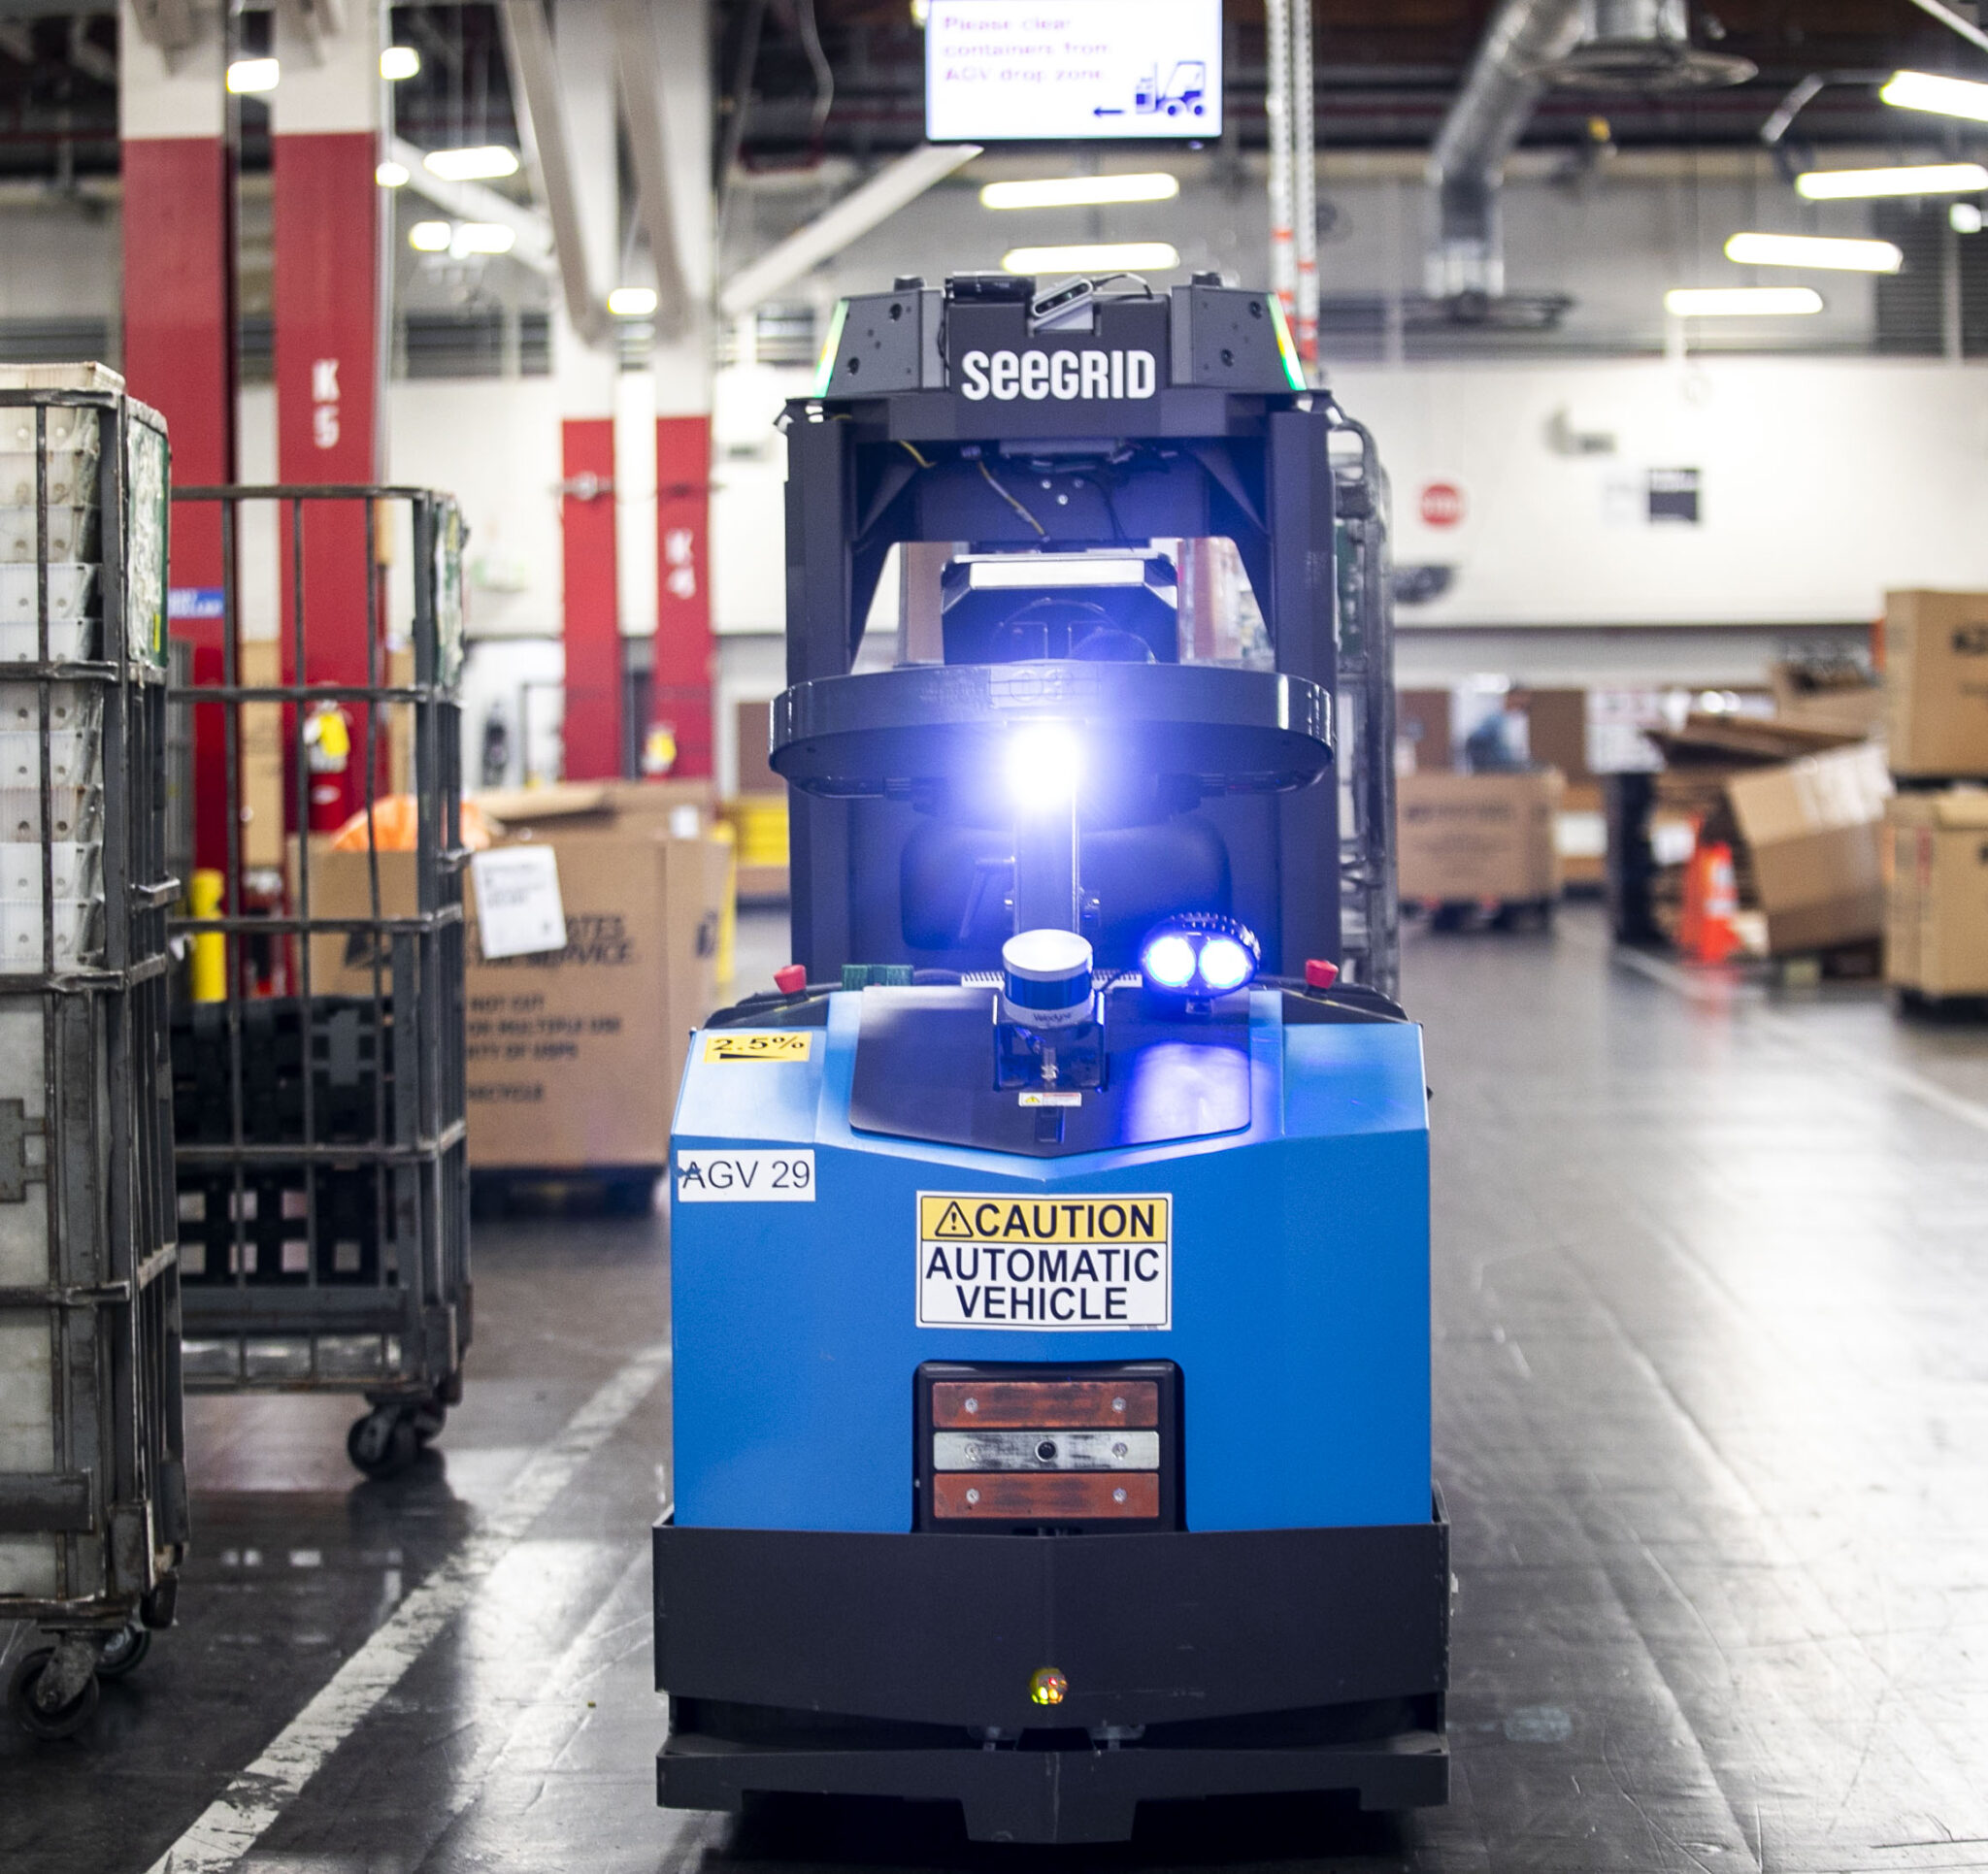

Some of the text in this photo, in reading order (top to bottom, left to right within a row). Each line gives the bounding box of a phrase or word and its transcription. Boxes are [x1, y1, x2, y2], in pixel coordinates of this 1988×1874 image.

[944, 16, 1071, 31] Please clear
[944, 43, 1054, 57] containers
[944, 67, 1103, 83] AGV drop zone
[712, 1036, 805, 1051] 2.5%
[682, 1161, 811, 1189] AGV 29
[975, 1203, 1155, 1238] CAUTION
[926, 1247, 1159, 1282] AUTOMATIC
[956, 1286, 1127, 1320] VEHICLE
